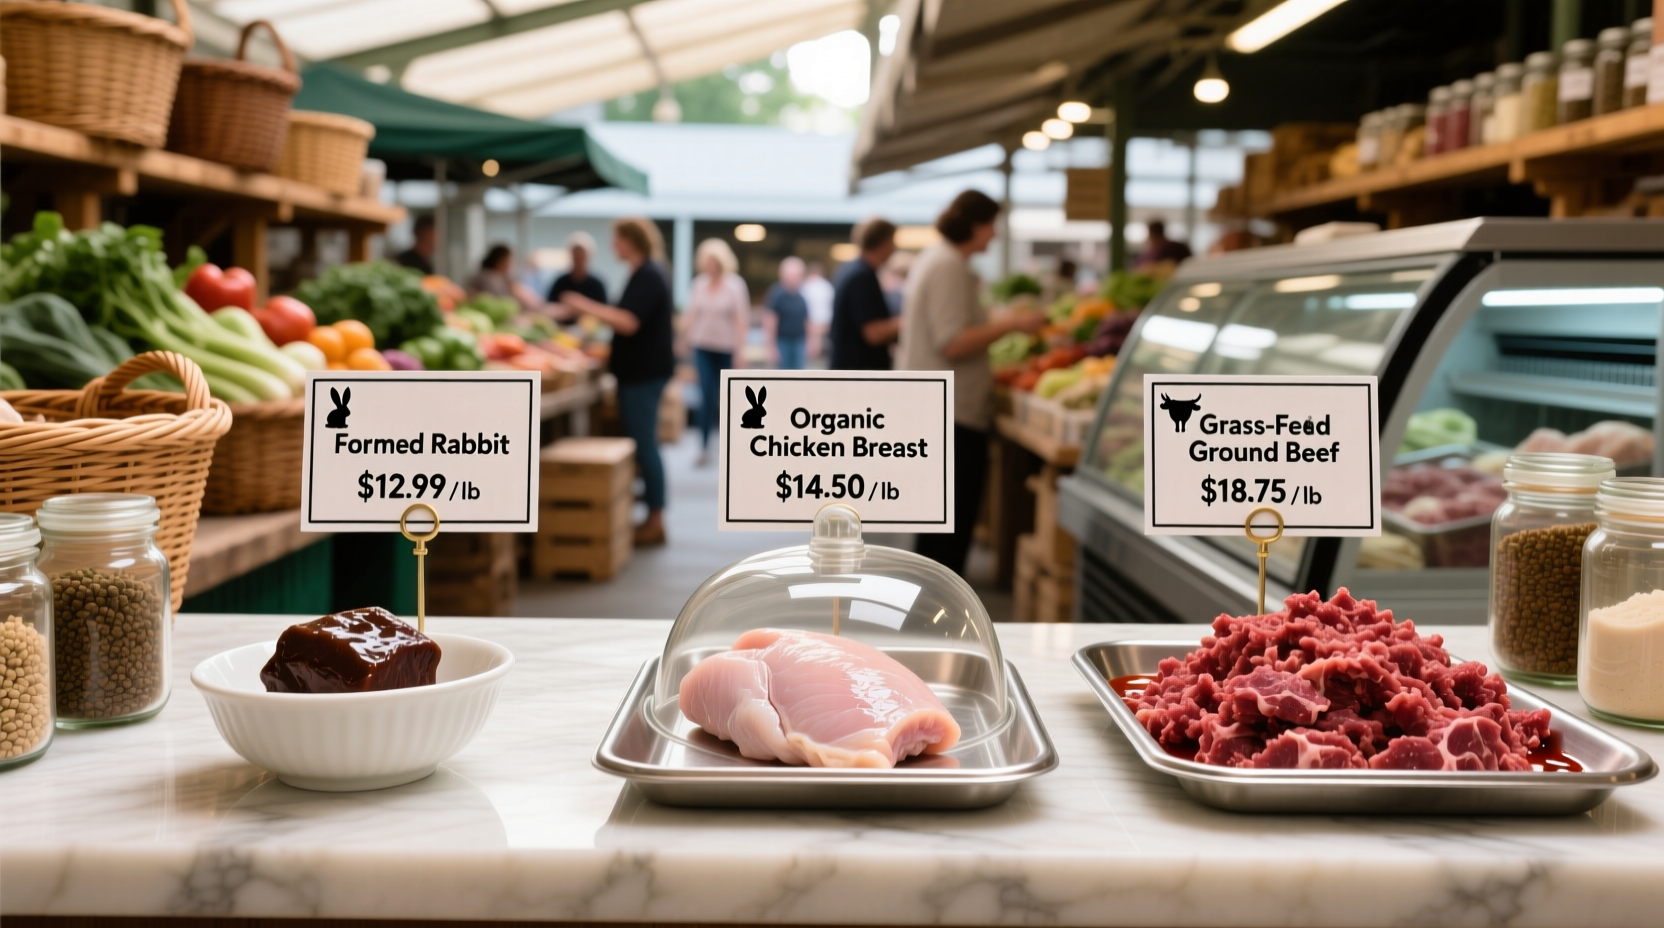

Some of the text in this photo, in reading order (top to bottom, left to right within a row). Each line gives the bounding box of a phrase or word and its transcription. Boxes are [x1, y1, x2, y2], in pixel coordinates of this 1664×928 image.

[790, 406, 885, 436] Organic
[334, 431, 510, 455] Formed Rabbit
[749, 434, 929, 458] Chicken Breast
[1188, 439, 1340, 463] Ground Beef
[357, 469, 447, 504] $12.99
[775, 469, 865, 504] $14.50
[1200, 473, 1287, 507] $18.75
